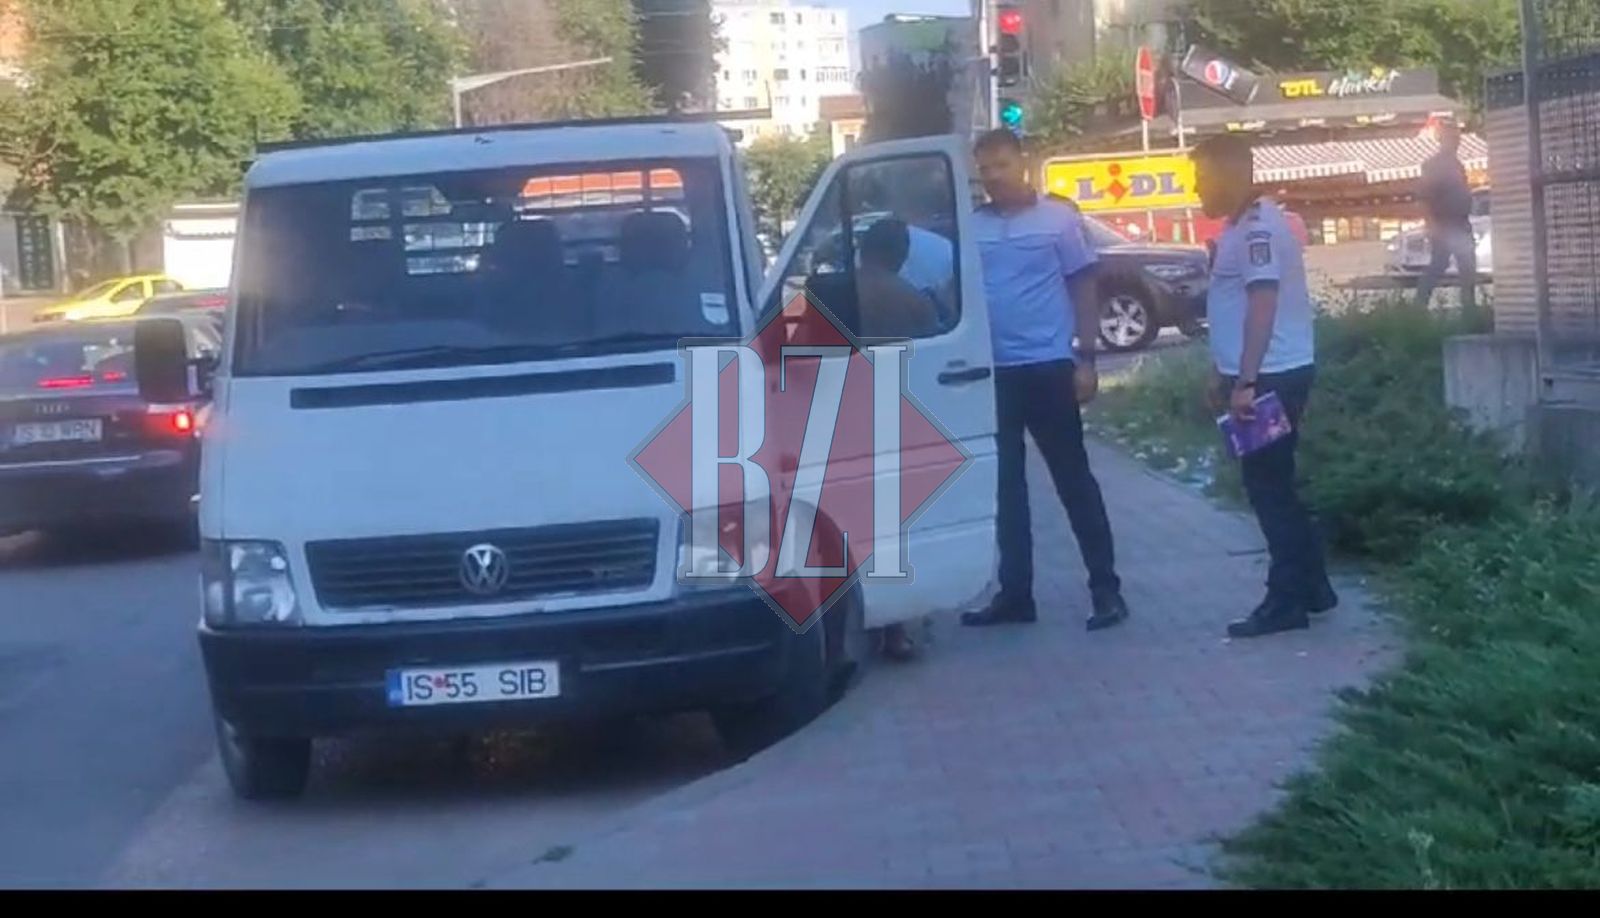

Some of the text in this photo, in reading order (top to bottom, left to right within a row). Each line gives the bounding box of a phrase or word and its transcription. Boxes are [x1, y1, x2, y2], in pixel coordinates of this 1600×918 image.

[407, 668, 547, 701] IS 55 SIB
